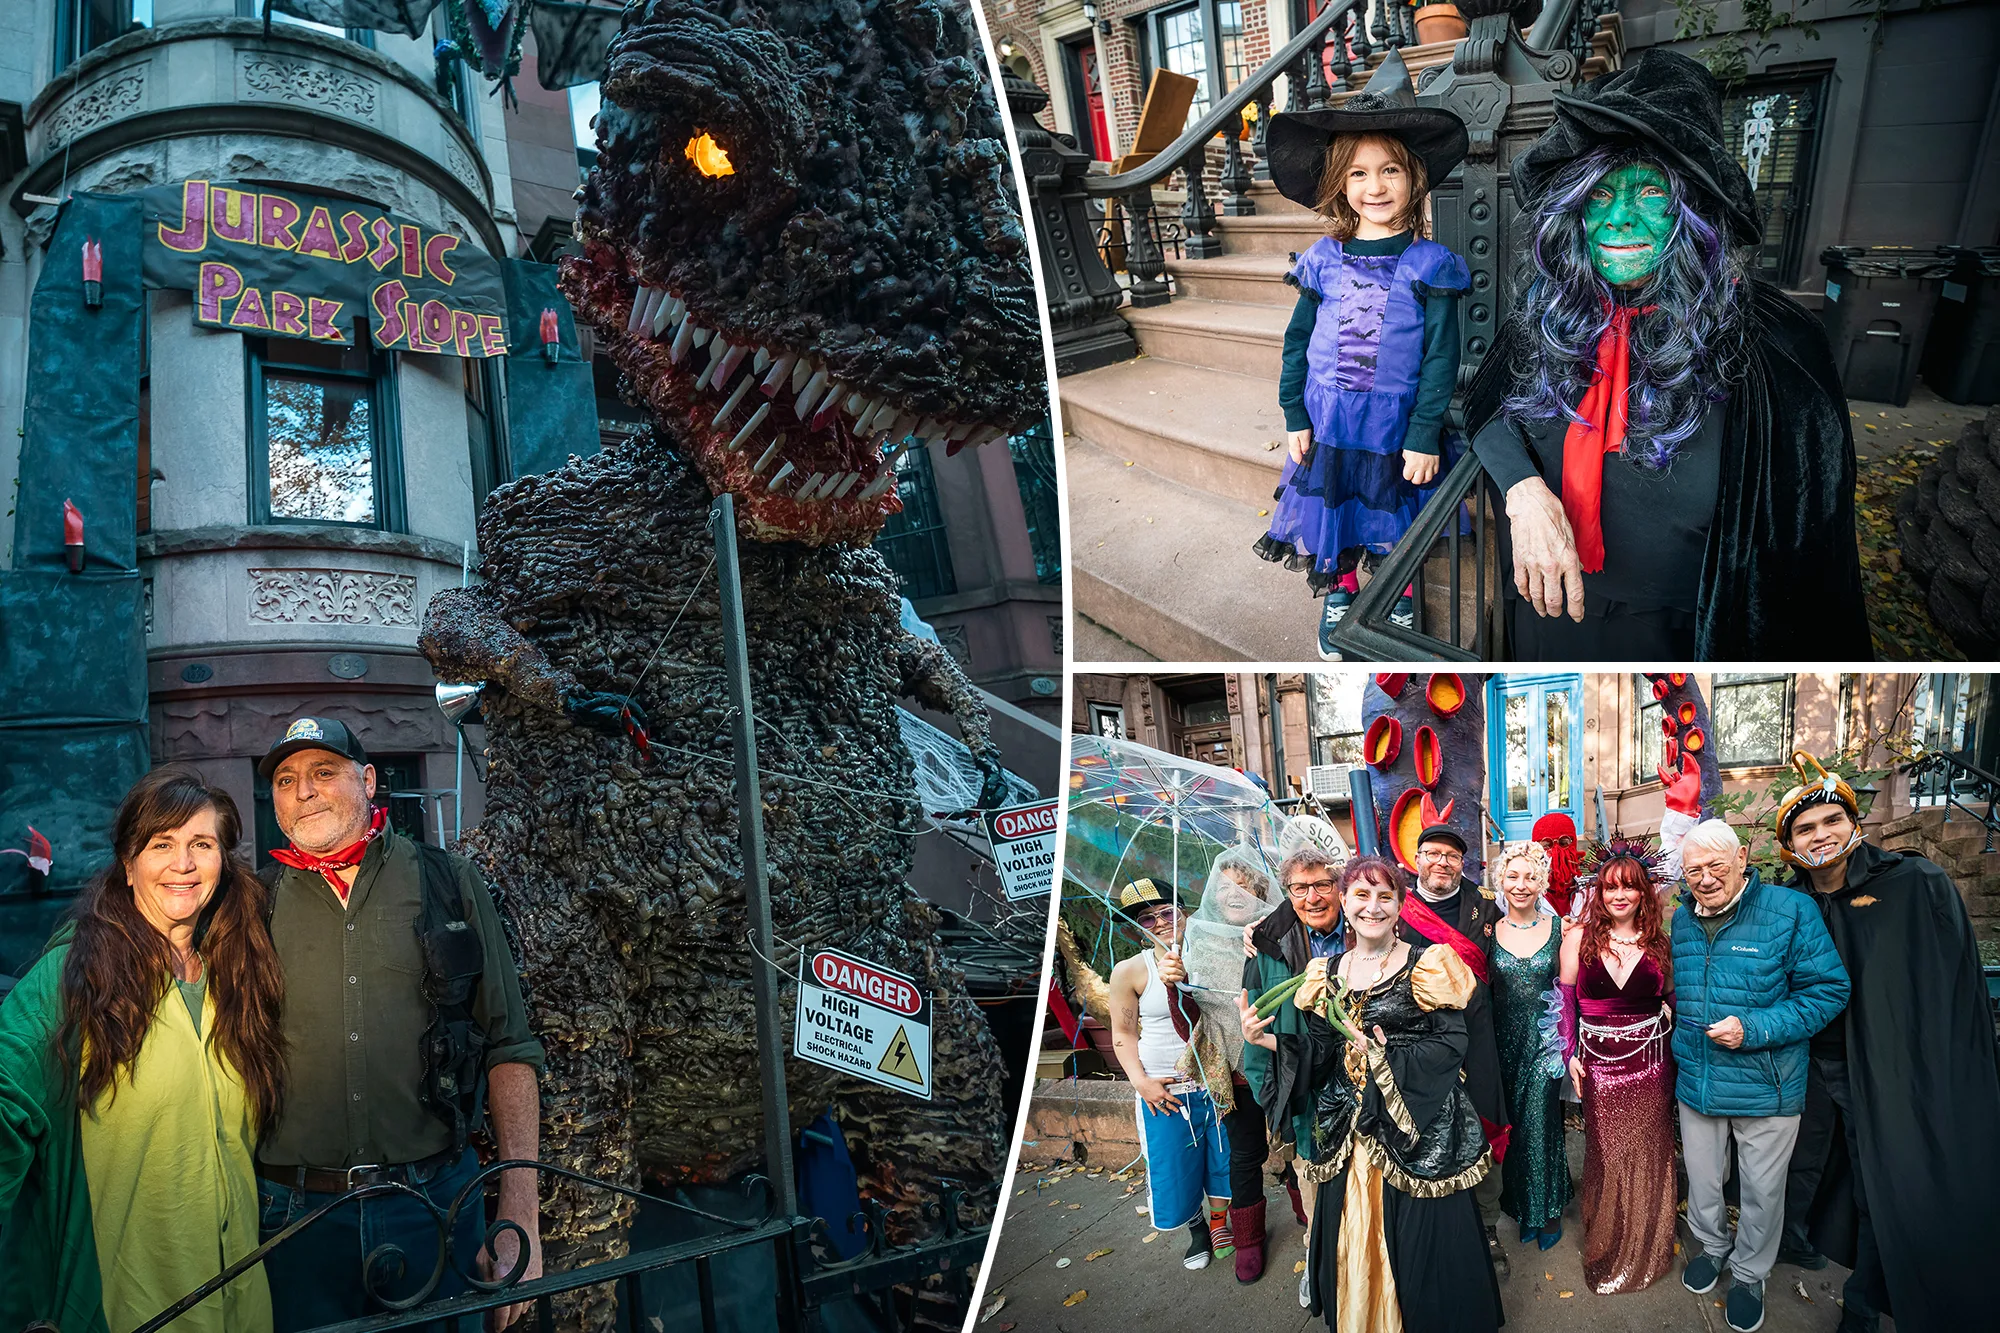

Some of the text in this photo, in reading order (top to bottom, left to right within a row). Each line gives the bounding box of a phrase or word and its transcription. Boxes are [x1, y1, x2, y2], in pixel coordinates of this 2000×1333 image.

[158, 180, 460, 286] JURASSIC
[199, 262, 508, 356] PARK SLOPE
[1011, 839, 1043, 856] HIGH
[1014, 880, 1038, 893] SHOCK
[822, 958, 912, 1010] DANGER
[821, 993, 860, 1019] HIGH
[805, 1007, 874, 1044] VOLTAGE
[806, 1041, 872, 1070] SHOCK HAZARD
[814, 1031, 863, 1055] ELECTRICAL
